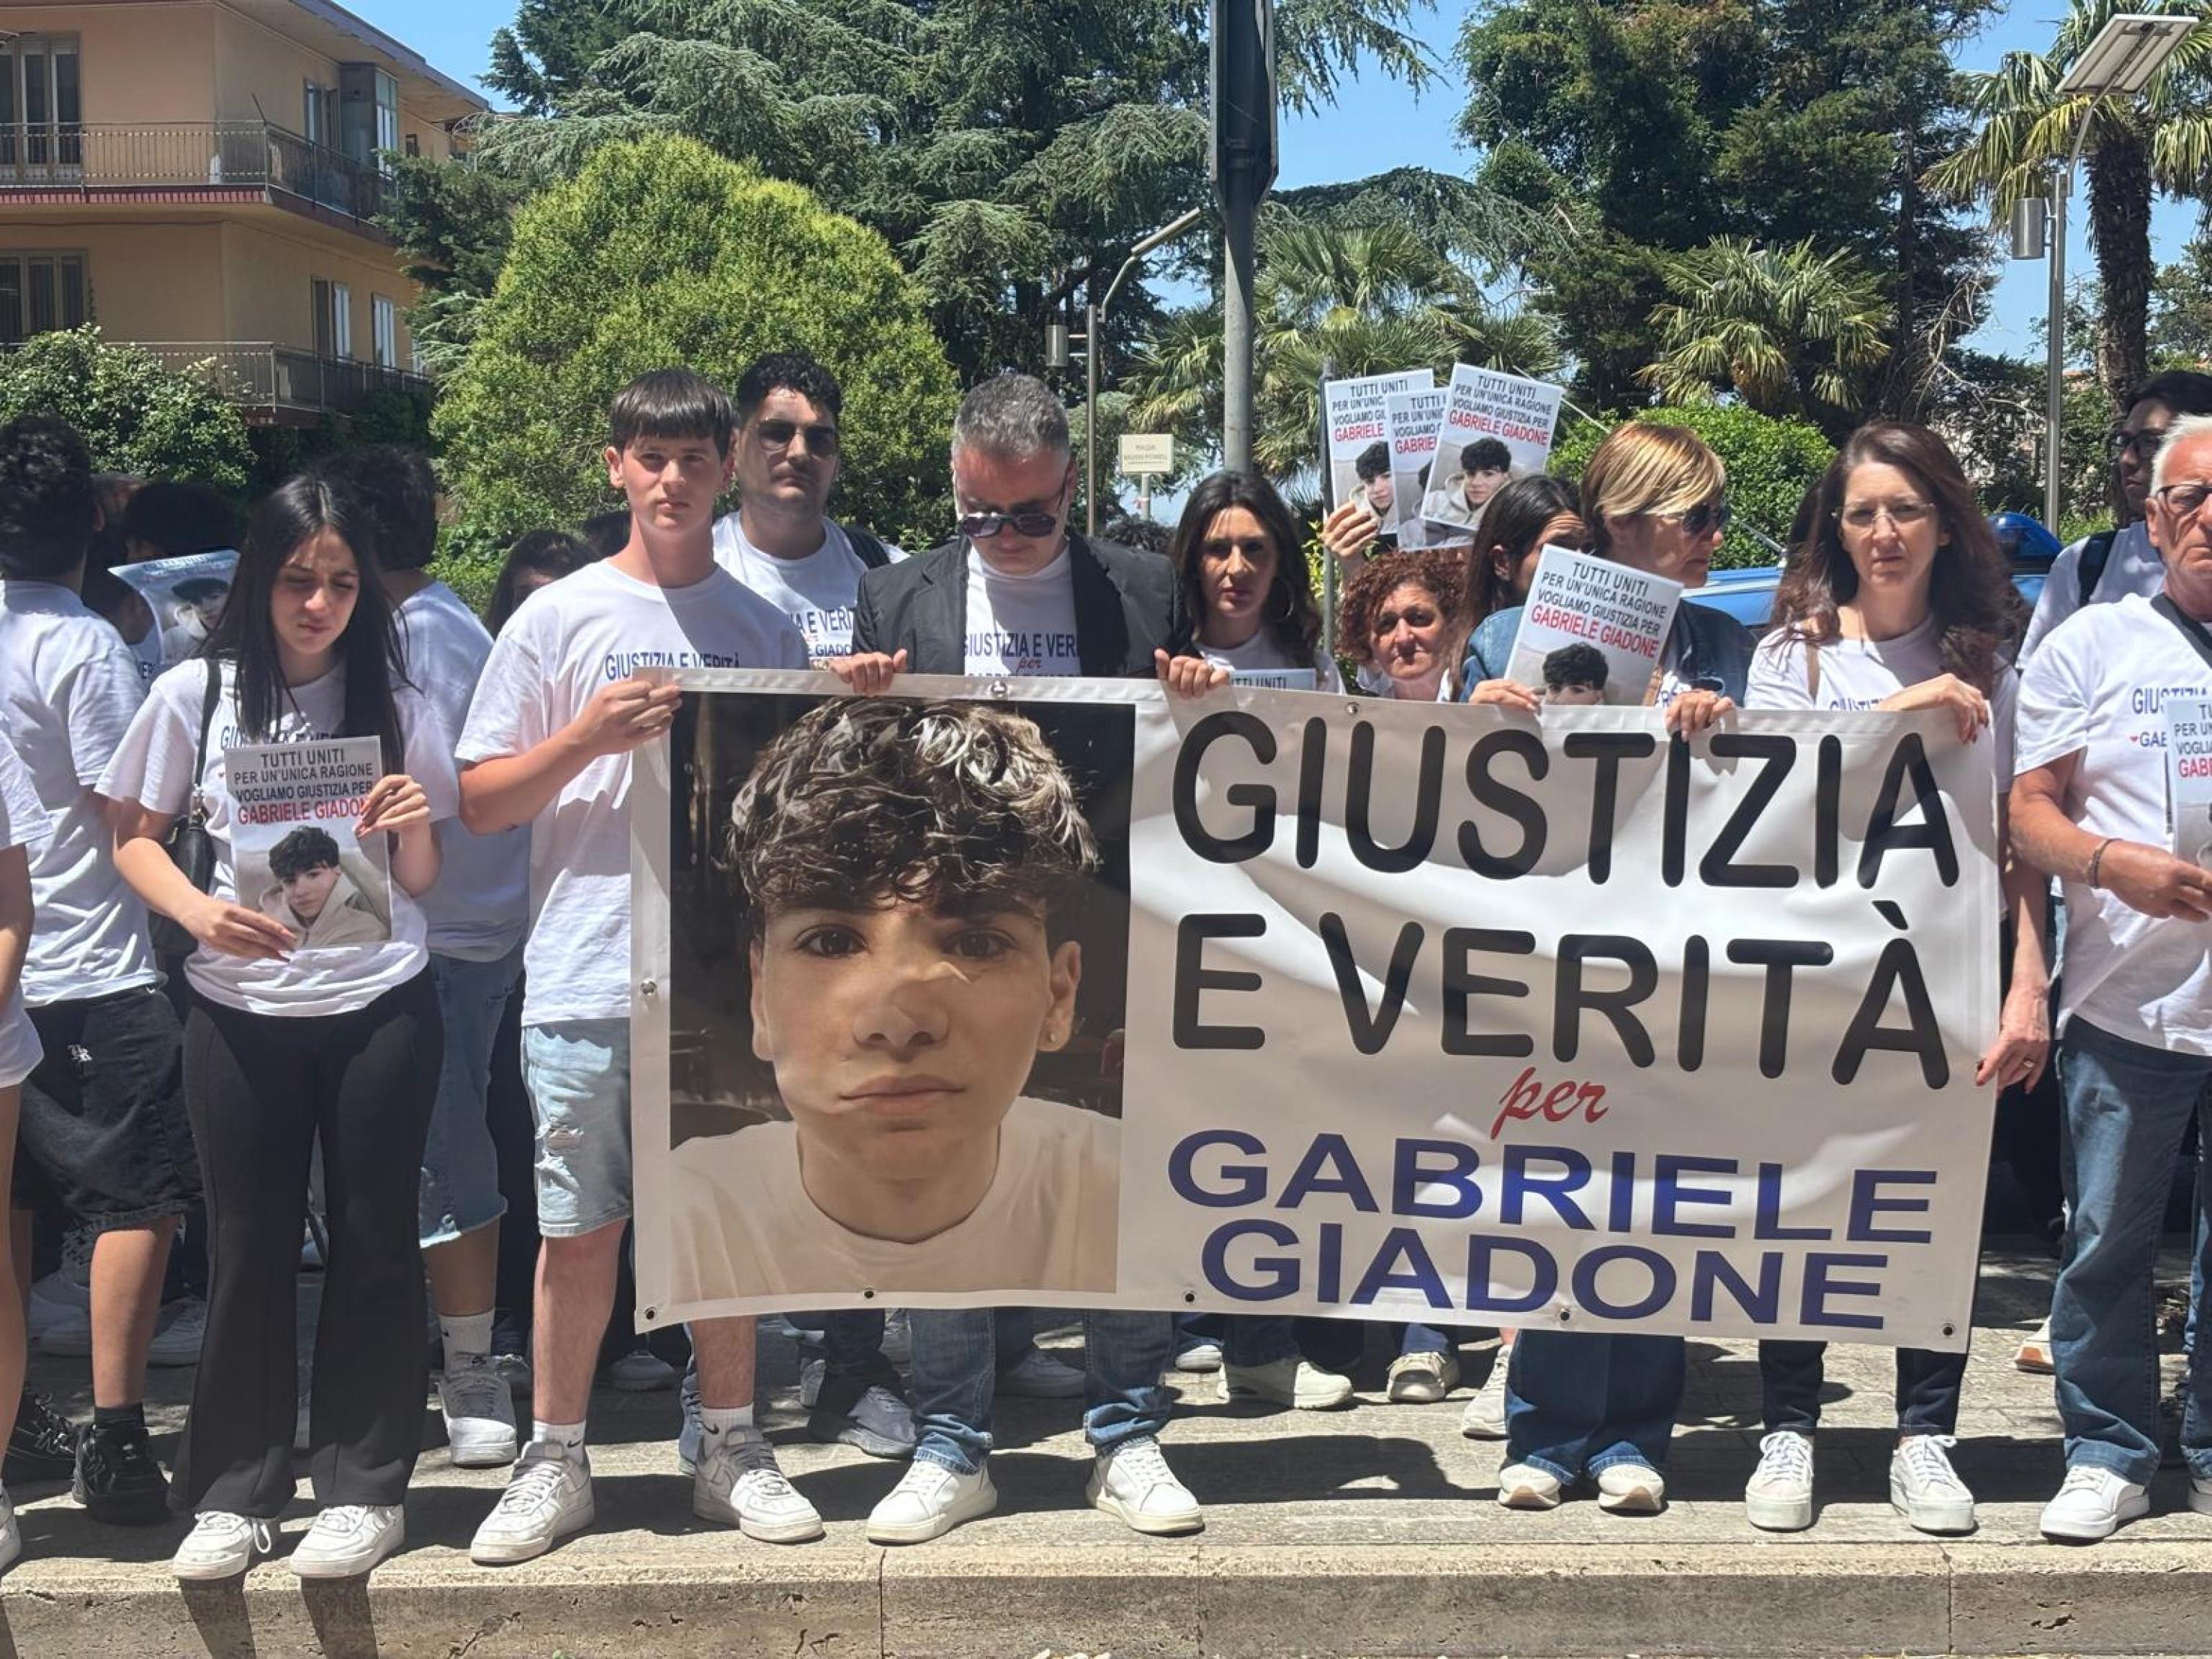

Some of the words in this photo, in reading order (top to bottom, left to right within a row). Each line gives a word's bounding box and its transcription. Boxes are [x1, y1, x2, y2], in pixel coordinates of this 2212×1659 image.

[1350, 383, 1377, 397] TUTTI
[1381, 379, 1408, 394] UNITI
[1455, 384, 1473, 396] PER
[1515, 397, 1552, 415] RAGIONE
[1478, 375, 1506, 392] TUTTI
[1509, 383, 1537, 400] UNITI
[1332, 400, 1349, 412] PER
[1350, 395, 1385, 410] UN'UNIC
[1411, 395, 1440, 409] TUTTI
[1335, 422, 1385, 442] GABRIELE
[1450, 409, 1501, 434] GABRIELE
[1502, 422, 1550, 446] GIADONE
[1532, 415, 1550, 428] PER
[1573, 562, 1611, 585] TUTTI
[1614, 574, 1649, 597] UNITI
[1542, 572, 1564, 588] PER
[1566, 577, 1617, 602] UN'UNICA
[1620, 594, 1667, 619] RAGIONE
[1538, 588, 1591, 614] VOGLIAMO
[1592, 604, 1639, 630] GIUSTIZIA
[1640, 619, 1661, 637] PER
[1532, 604, 1599, 639] GABRIELE
[1600, 625, 1660, 658] GIADONE
[1033, 633, 1042, 657] E
[2173, 722, 2197, 736] PER
[261, 752, 302, 768] TUTTI
[306, 748, 344, 765] UNITI
[234, 771, 258, 784] PER
[261, 766, 318, 782] UN'UNICA
[320, 763, 374, 778] RAGIONE
[236, 786, 294, 803] VOGLIAMO
[297, 783, 350, 799] GIUSTIZIA
[351, 781, 373, 794] PER
[1173, 710, 1960, 889] GIUSTIZIA
[238, 801, 311, 824] GABRIELE
[1173, 913, 1267, 1050] E
[1318, 900, 1951, 1090] VERITÀ
[1491, 1066, 1609, 1140] per
[1168, 1129, 1938, 1244] GABRIELE
[1201, 1218, 1889, 1330] GIADONE
